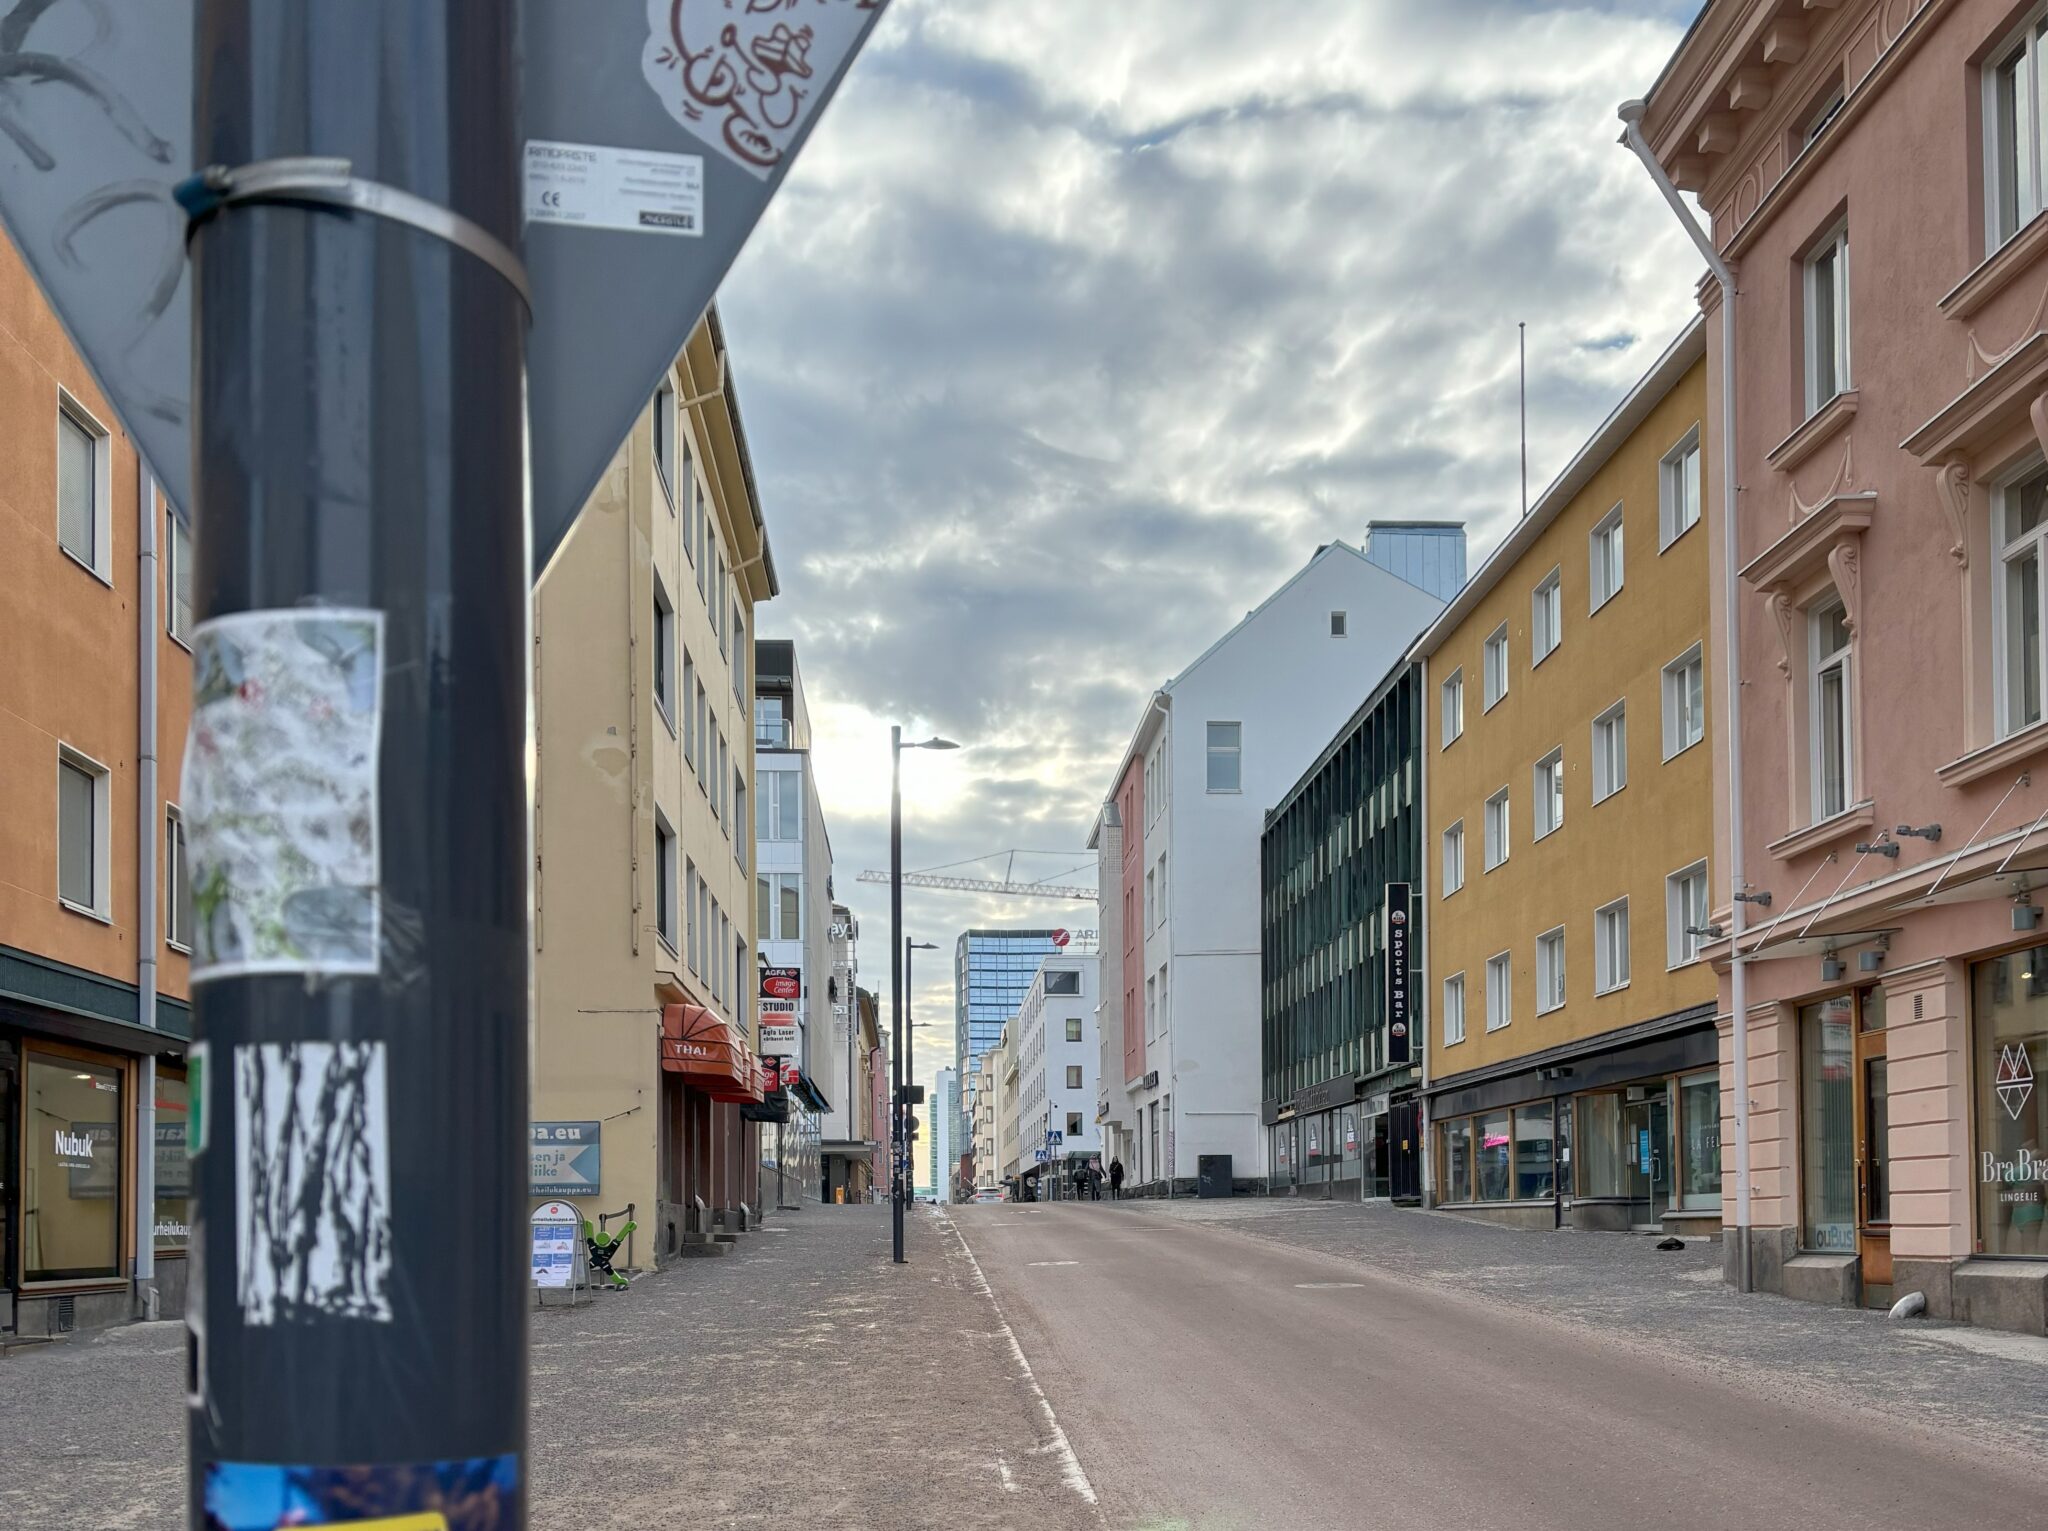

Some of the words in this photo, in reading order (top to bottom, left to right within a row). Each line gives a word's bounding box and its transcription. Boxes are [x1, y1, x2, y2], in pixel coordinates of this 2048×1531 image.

[1394, 929, 1403, 985] Sports
[775, 980, 796, 988] Image
[773, 986, 795, 994] Center
[763, 1002, 794, 1011] STUDIO
[1393, 990, 1404, 1018] Bar
[778, 1028, 795, 1036] Laser
[675, 1044, 707, 1056] THAI
[55, 1130, 93, 1158] Nubuk
[552, 1149, 566, 1166] ja
[2000, 1191, 2038, 1202] LINGERIE
